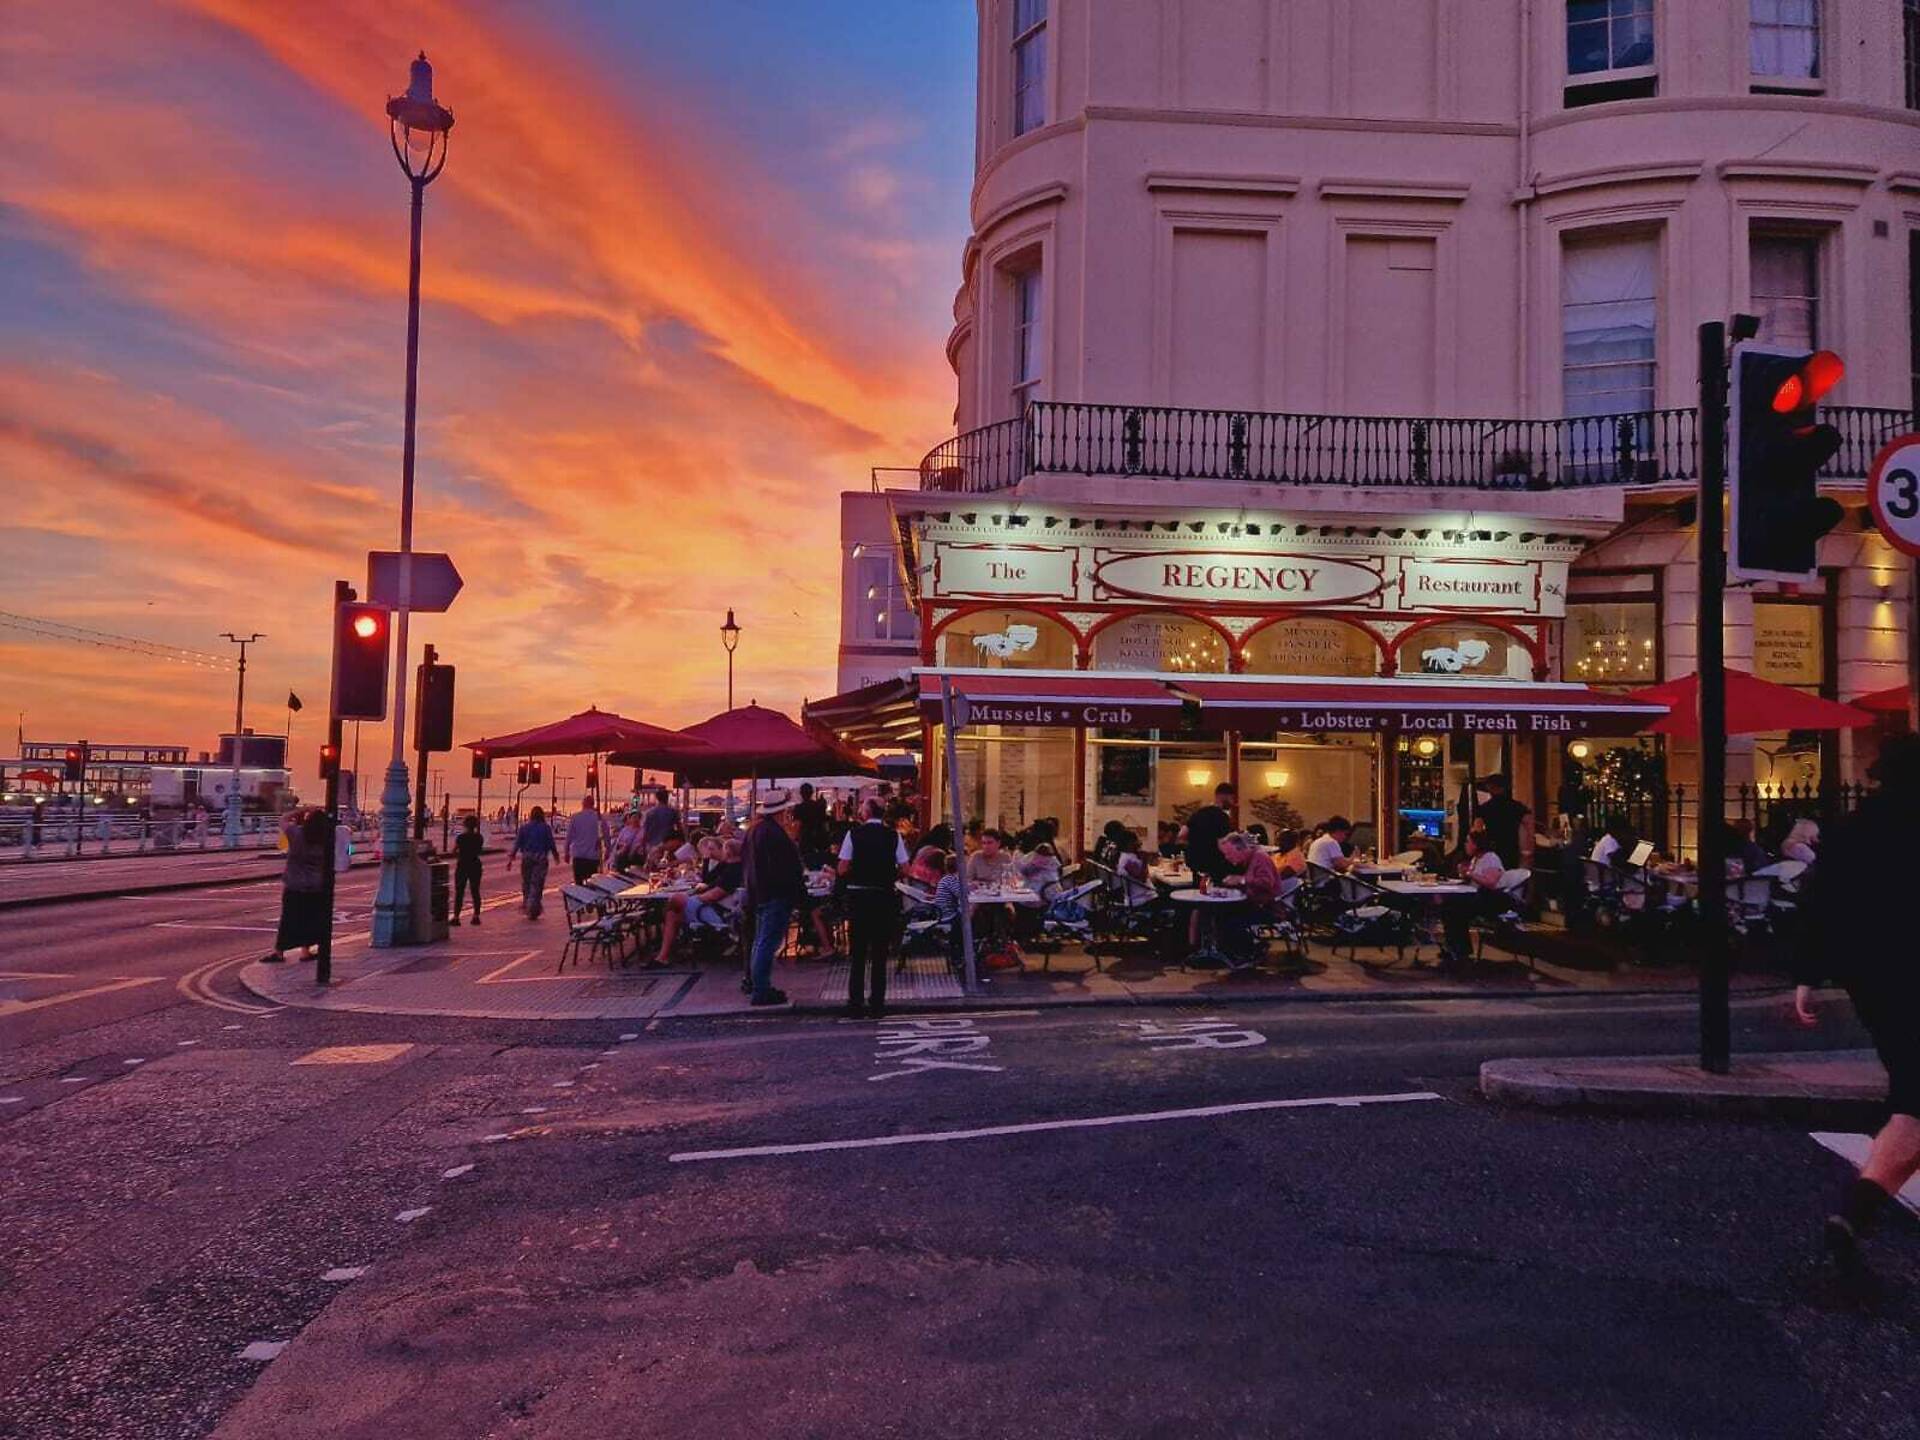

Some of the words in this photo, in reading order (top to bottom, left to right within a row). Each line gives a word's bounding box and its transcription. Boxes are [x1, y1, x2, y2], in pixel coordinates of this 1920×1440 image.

[1886, 468, 1919, 519] 3
[987, 562, 1027, 580] The
[1162, 563, 1321, 592] REGENCY
[1418, 575, 1523, 595] Restaurant
[970, 705, 1053, 722] Mussels
[1083, 707, 1133, 724] Crab
[1300, 711, 1374, 729] Lobster
[1401, 713, 1454, 729] Local
[1463, 714, 1517, 730] Fresh
[1531, 715, 1571, 731] Fish
